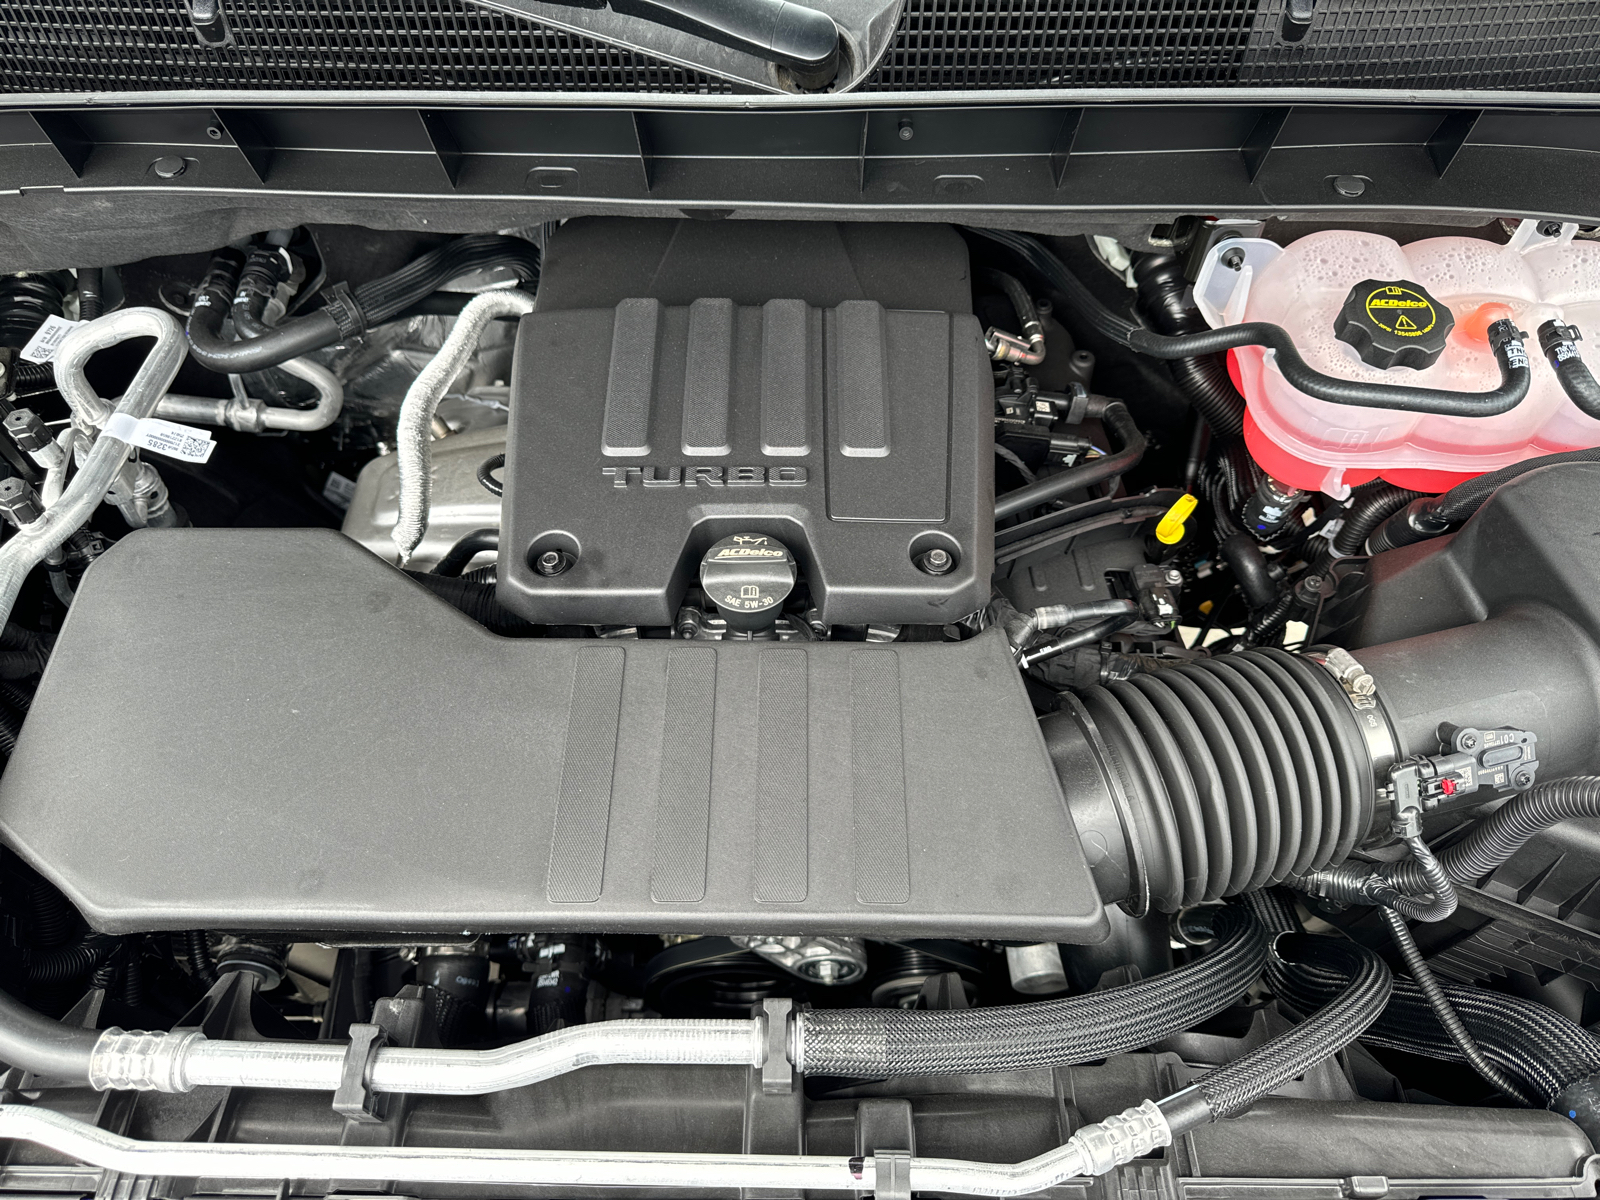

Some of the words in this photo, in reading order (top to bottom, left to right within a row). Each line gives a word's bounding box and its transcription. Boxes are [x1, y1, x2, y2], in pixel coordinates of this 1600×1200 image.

[1370, 299, 1427, 307] ACDelco
[147, 439, 168, 451] 3285
[602, 466, 807, 488] TURBO
[717, 548, 784, 557] ACDelco
[725, 595, 741, 607] SAE
[744, 596, 774, 609] 5W-30
